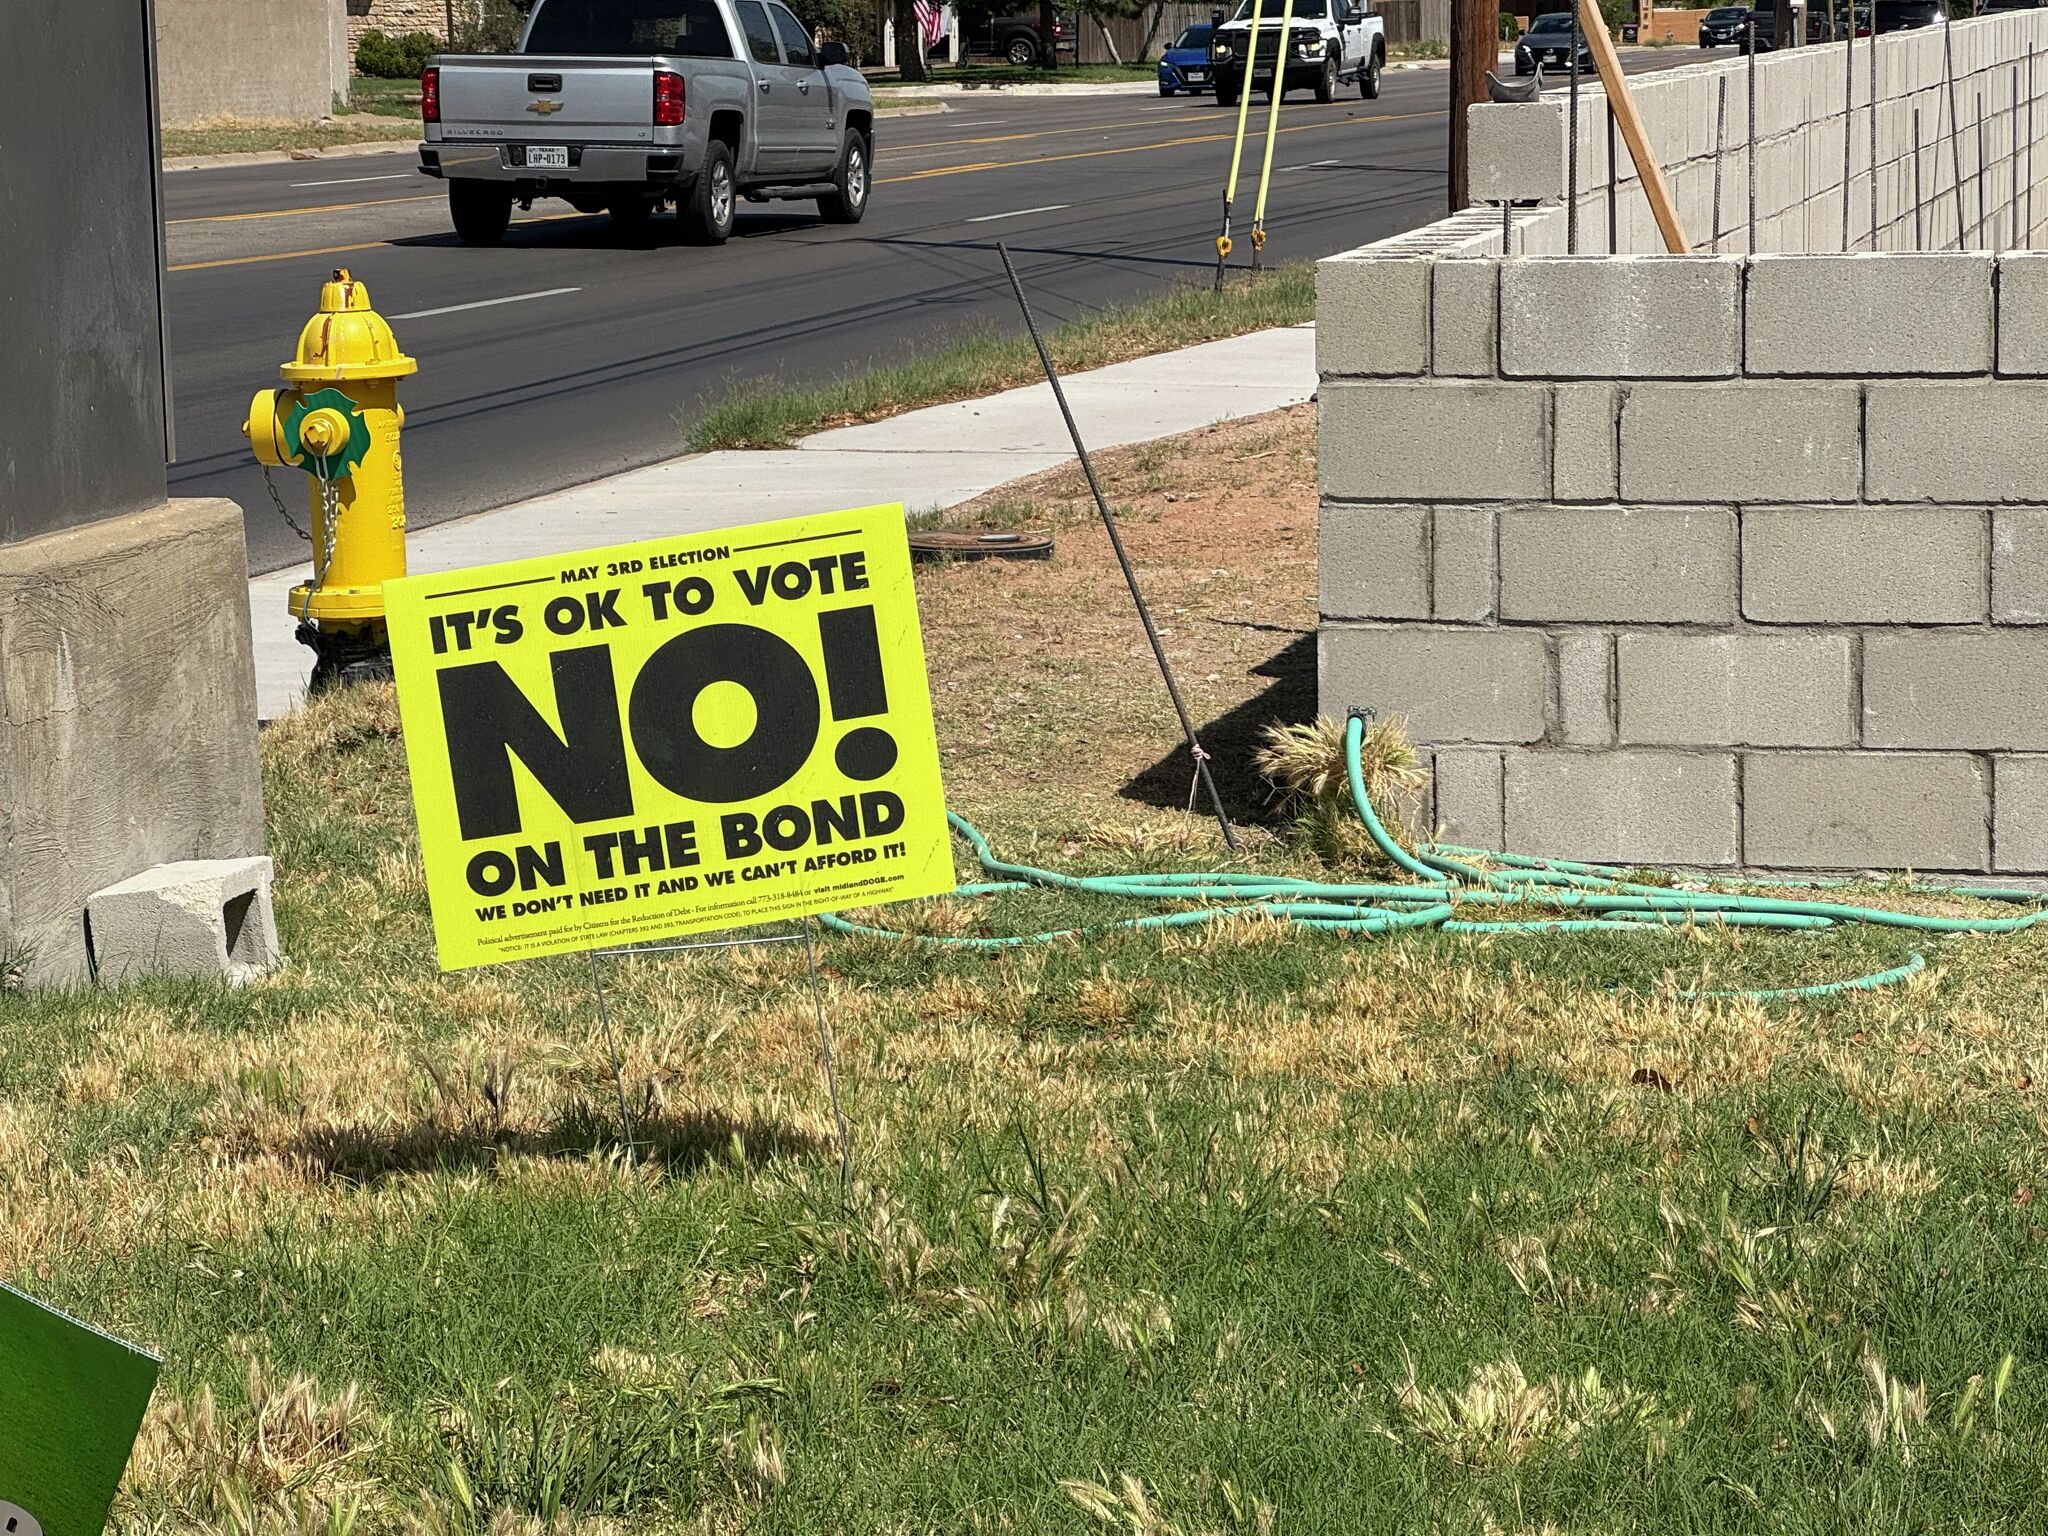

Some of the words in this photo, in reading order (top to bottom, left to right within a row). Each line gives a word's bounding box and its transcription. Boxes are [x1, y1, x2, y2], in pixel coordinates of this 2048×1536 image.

[428, 604, 524, 654] IT'S
[543, 588, 628, 635] OK
[641, 576, 714, 621] TO
[732, 550, 870, 606] VOTE
[561, 565, 599, 584] MAY
[606, 559, 643, 576] 3RD
[649, 545, 730, 570] ELECTION
[435, 604, 898, 841] NO!
[465, 840, 566, 897] ON
[582, 820, 701, 880] THE
[719, 790, 905, 860] BOND
[474, 904, 507, 922] WE
[512, 894, 573, 917] DON'T
[579, 886, 628, 907] NEED
[633, 882, 650, 898] IT
[657, 876, 698, 895] AND
[703, 869, 735, 887] WE
[741, 859, 797, 881] CAN'T
[803, 847, 877, 872] AFFORD
[882, 841, 906, 859] IT!
[477, 935, 503, 946] Political
[504, 930, 548, 942] advertisement
[548, 926, 563, 937] paid
[563, 925, 573, 933] for
[582, 921, 609, 930] Citizens
[620, 916, 631, 924] the
[631, 913, 665, 922] Reduction
[673, 907, 691, 916] Debt
[695, 905, 706, 913] For
[707, 900, 745, 911] information
[746, 896, 757, 905] call
[813, 885, 831, 894] visit
[832, 874, 905, 891] midlandDOGE.com
